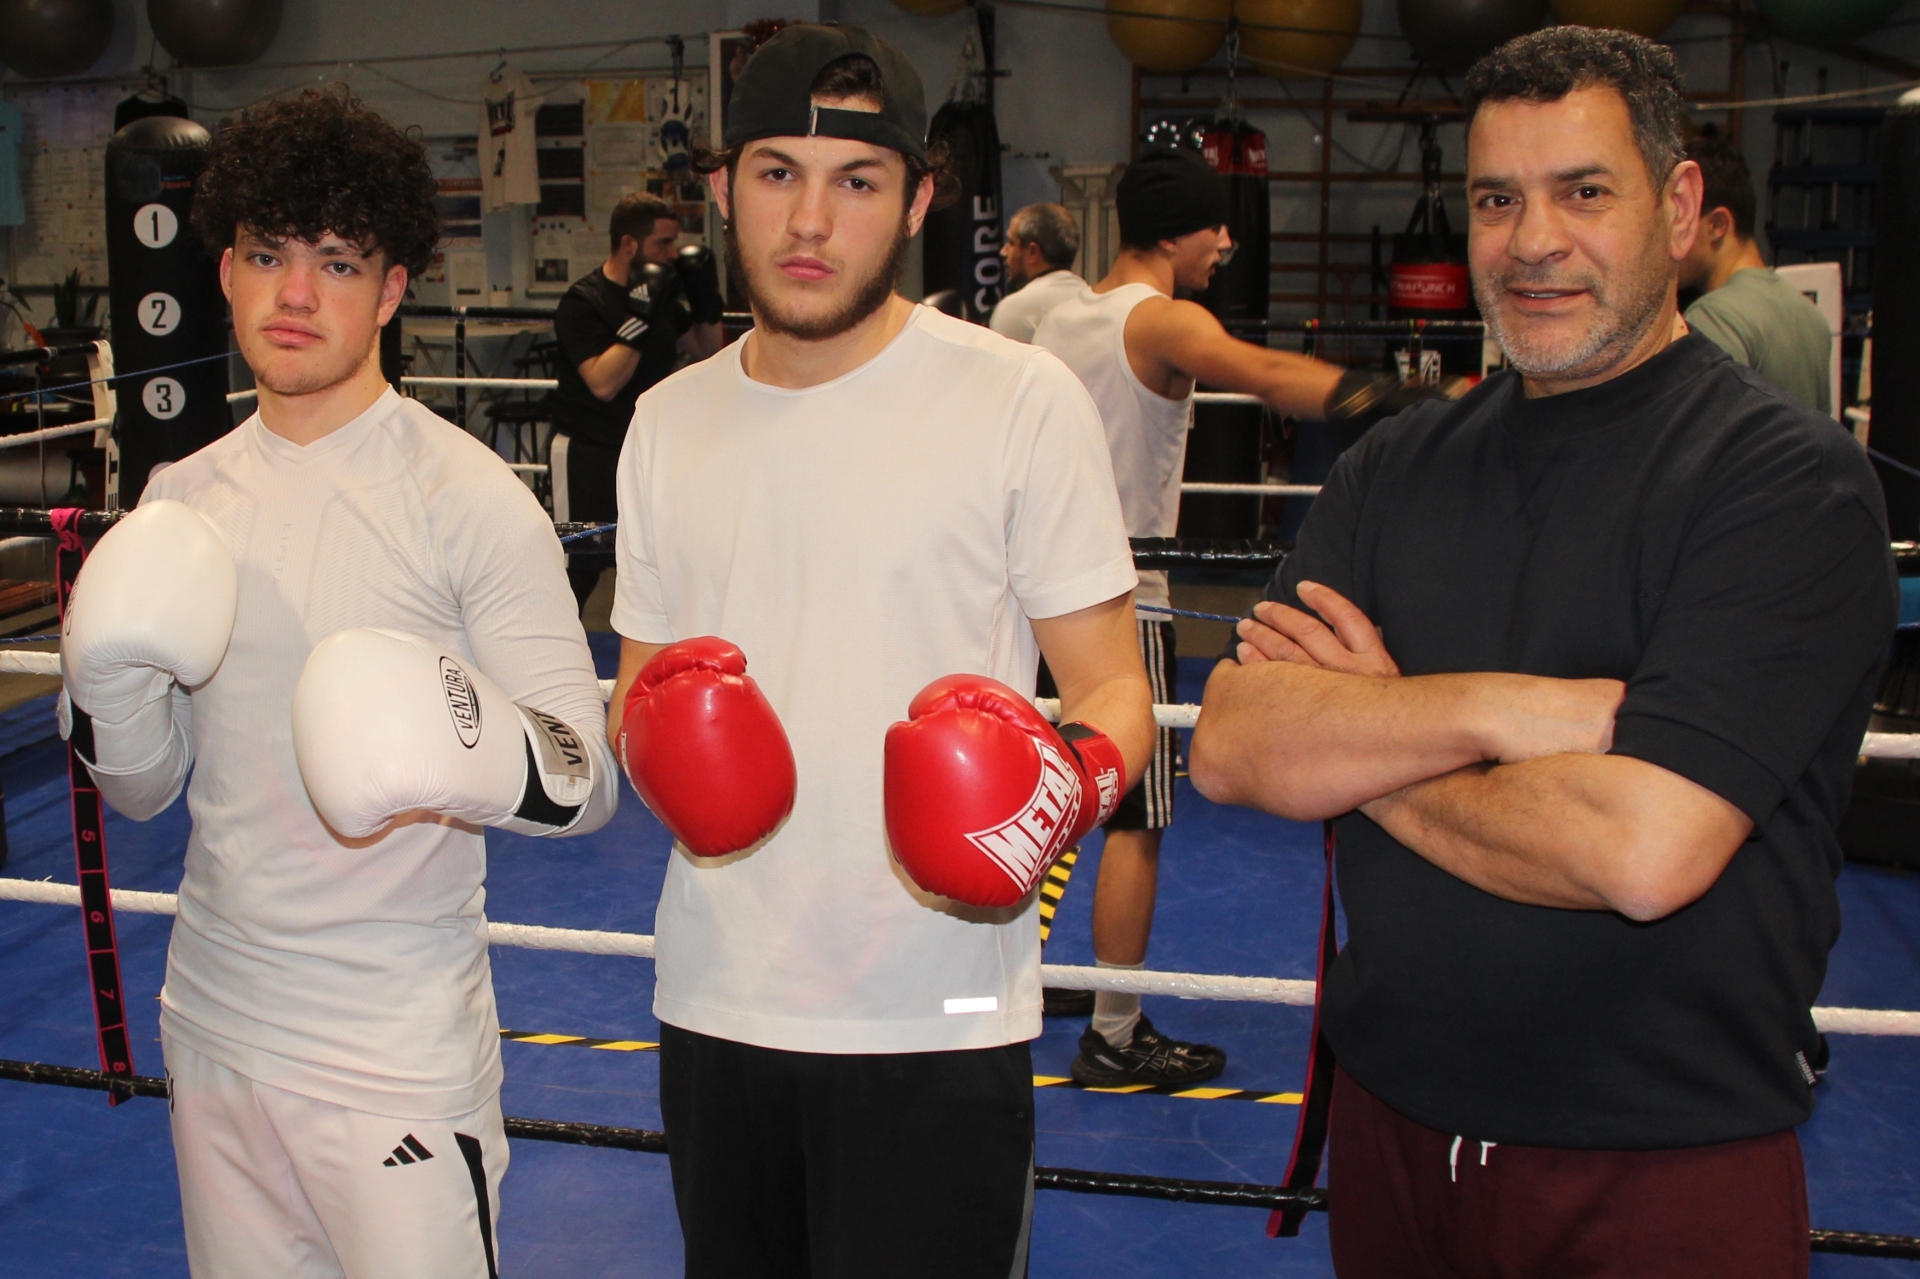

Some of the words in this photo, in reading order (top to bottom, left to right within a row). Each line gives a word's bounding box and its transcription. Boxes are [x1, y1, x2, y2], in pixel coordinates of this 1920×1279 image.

[151, 211, 159, 242] 1
[151, 299, 167, 329] 2
[155, 384, 172, 413] 3
[271, 523, 293, 585] KIPSTA
[445, 668, 474, 730] VENTURA
[528, 706, 584, 766] VENT
[976, 743, 1078, 888] METAL
[81, 829, 95, 842] 5
[90, 911, 105, 923] 6
[100, 988, 115, 1000] 7
[112, 1061, 126, 1073] 8
